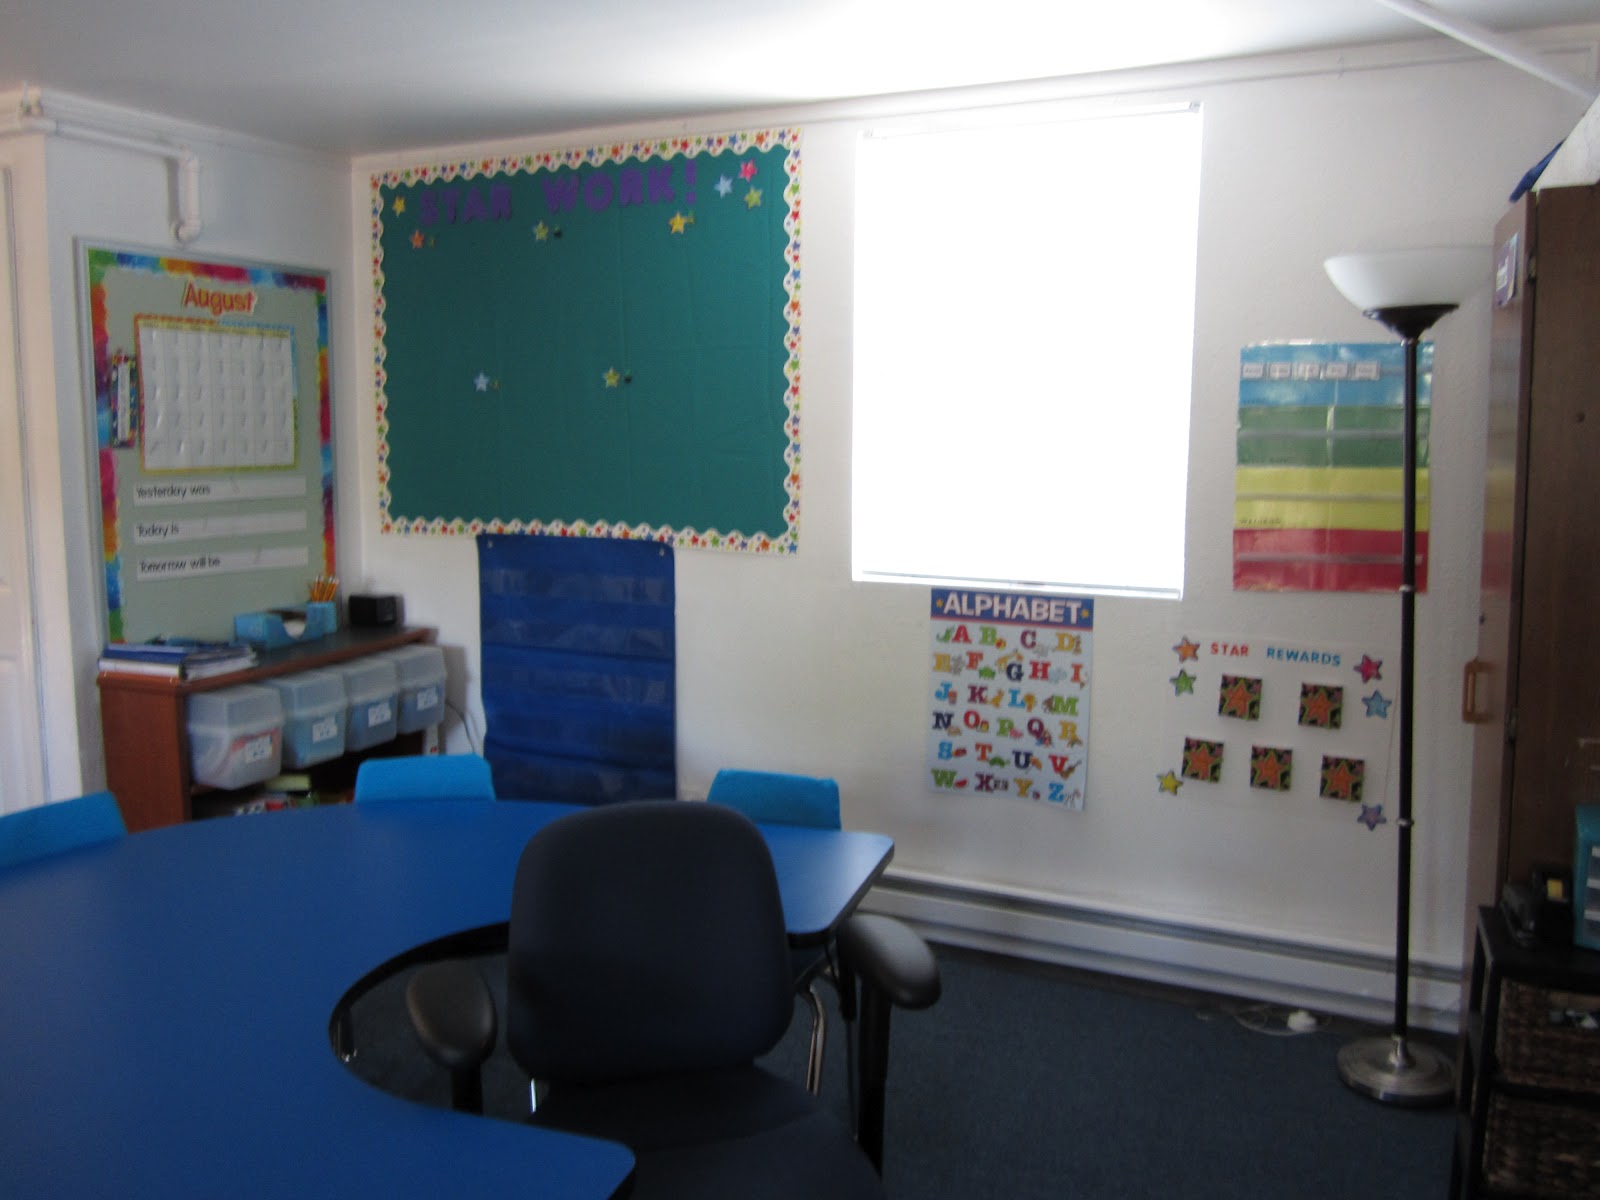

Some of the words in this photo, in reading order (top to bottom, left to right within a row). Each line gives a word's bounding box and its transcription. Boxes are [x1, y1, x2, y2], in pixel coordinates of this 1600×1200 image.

[420, 186, 512, 225] STAR
[542, 160, 697, 213] WORK!
[184, 282, 254, 316] August
[136, 483, 187, 500] Yesterday
[190, 484, 211, 496] was
[137, 522, 169, 539] Today
[171, 521, 180, 535] is
[140, 559, 187, 574] Tomorrow
[190, 556, 206, 570] will
[208, 555, 221, 567] be
[944, 592, 1081, 623] ALPHABET
[953, 625, 973, 644] A
[1021, 630, 1037, 649] C
[1056, 633, 1074, 652] D
[967, 652, 983, 670] F
[1007, 663, 1024, 682] G
[1030, 661, 1051, 680] H
[1072, 664, 1083, 682] I
[1210, 641, 1249, 657] STAR
[1266, 647, 1341, 667] REWARDS
[936, 683, 952, 700] J
[969, 685, 988, 704] K
[1009, 689, 1026, 708] L
[1053, 696, 1079, 716] M
[933, 712, 954, 730] N
[964, 711, 980, 729] O
[997, 718, 1014, 737] P
[1028, 719, 1044, 739] Q
[1060, 721, 1079, 740] R
[976, 743, 992, 762] T
[1013, 751, 1033, 769] U
[1049, 755, 1068, 774] V
[932, 769, 957, 788] W
[975, 774, 994, 792] X
[1014, 778, 1033, 798] Y
[1049, 784, 1064, 803] Z
